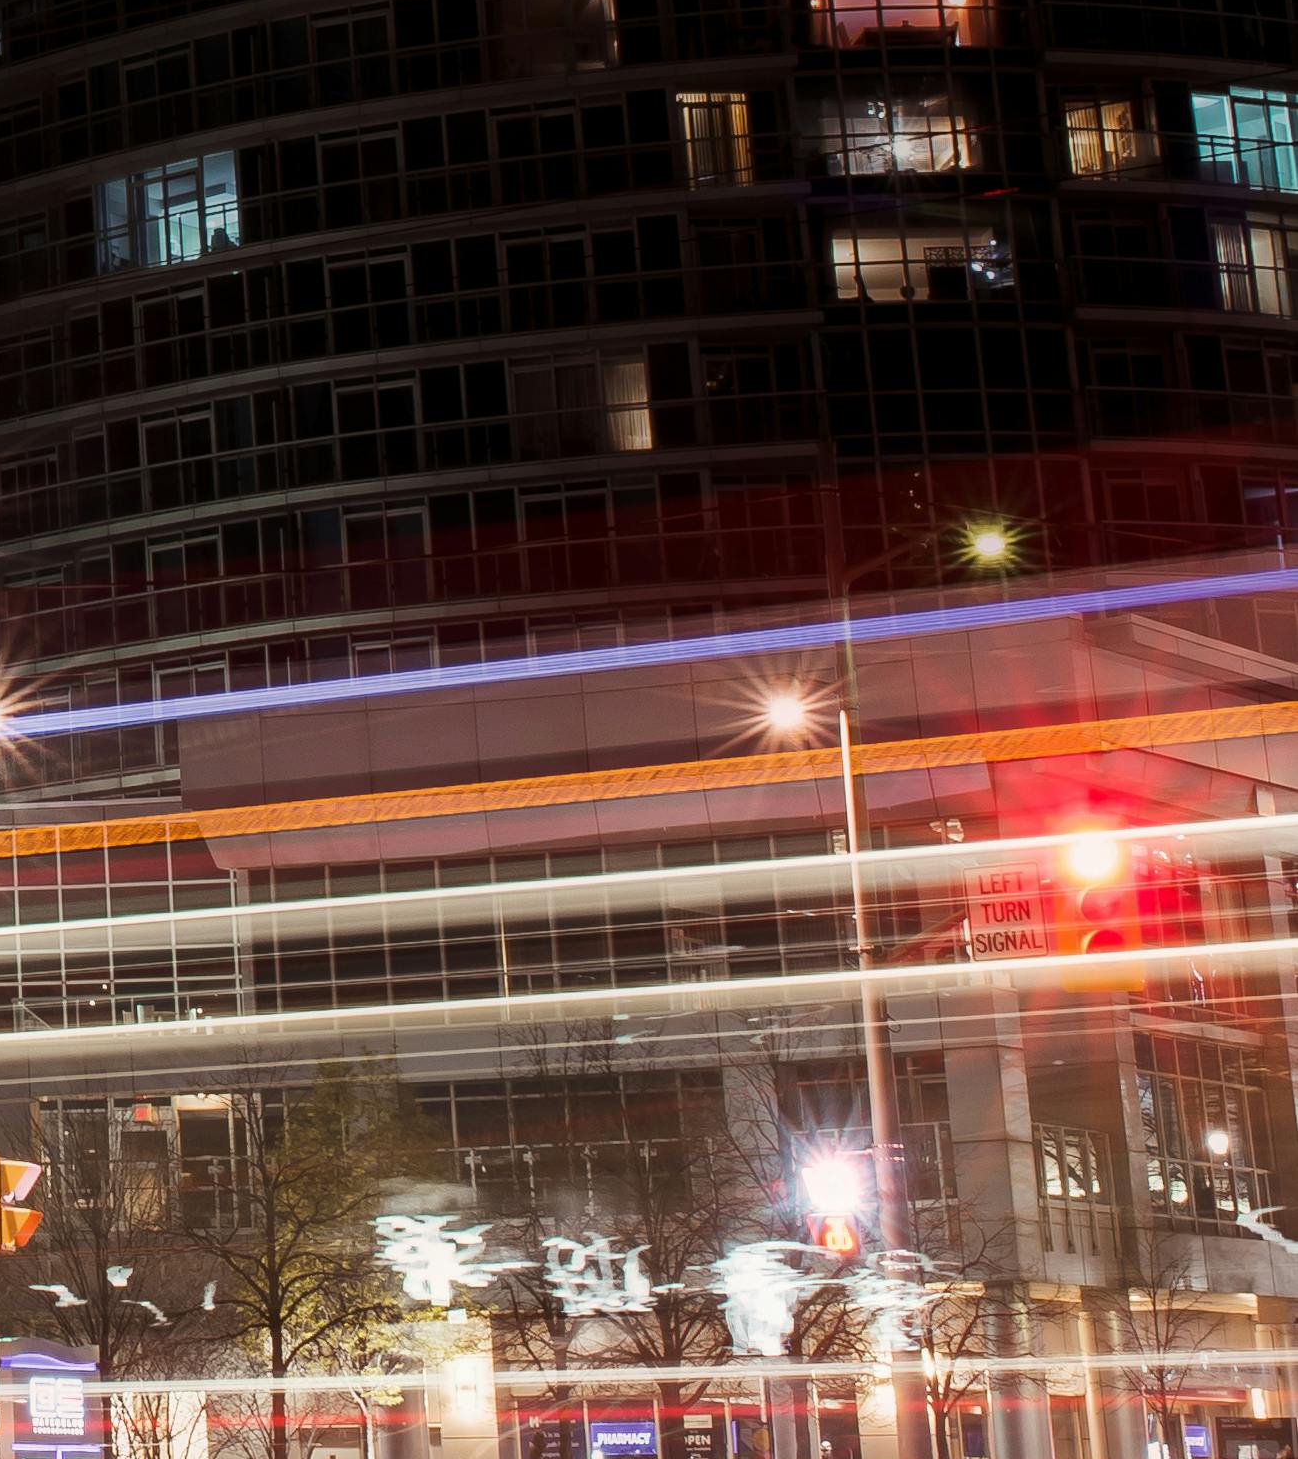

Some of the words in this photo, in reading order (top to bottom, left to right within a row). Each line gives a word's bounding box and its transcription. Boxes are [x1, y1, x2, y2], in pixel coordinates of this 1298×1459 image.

[978, 872, 1023, 895] LEFT
[981, 900, 1031, 924] TURN
[975, 929, 1044, 953] SIGNAL
[596, 1432, 651, 1446] PHARMACY
